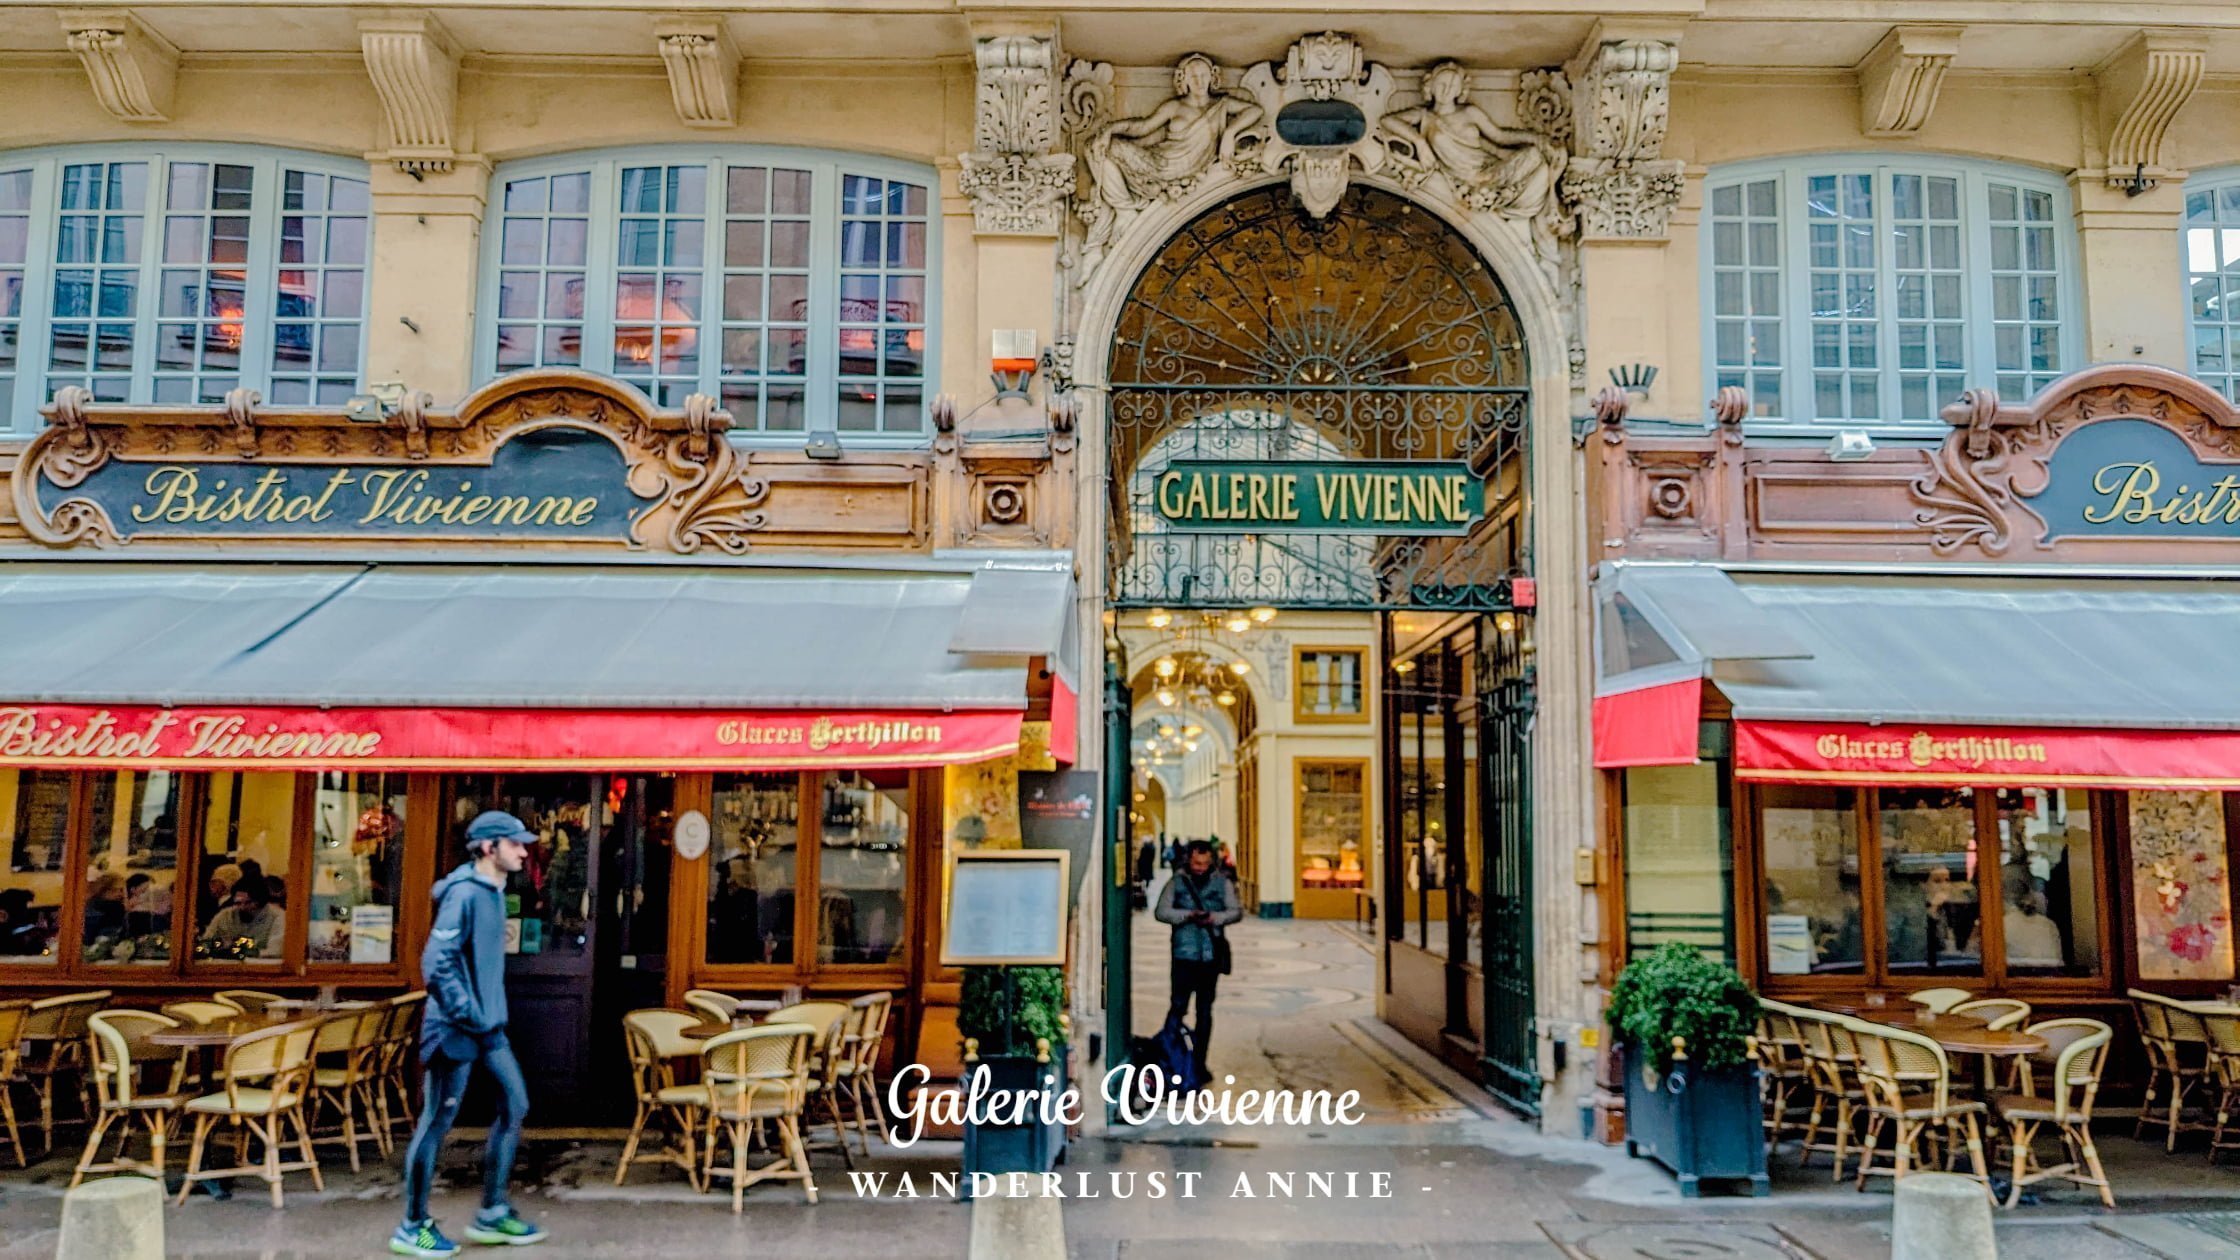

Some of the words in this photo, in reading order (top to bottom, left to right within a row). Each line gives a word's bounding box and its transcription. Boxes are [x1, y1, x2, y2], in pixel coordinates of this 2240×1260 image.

[131, 465, 356, 523] Bistrot
[359, 469, 599, 526] Vivienne
[1158, 471, 1300, 520] GALERIE
[1315, 473, 1470, 522] VIVIENNE
[0, 707, 180, 758] Bistrot
[183, 714, 382, 759] Vivienne
[716, 720, 802, 745] Glaces
[808, 716, 942, 751] Berthillon
[1816, 733, 1904, 759] Glaces
[1908, 731, 2047, 768] Berthillon
